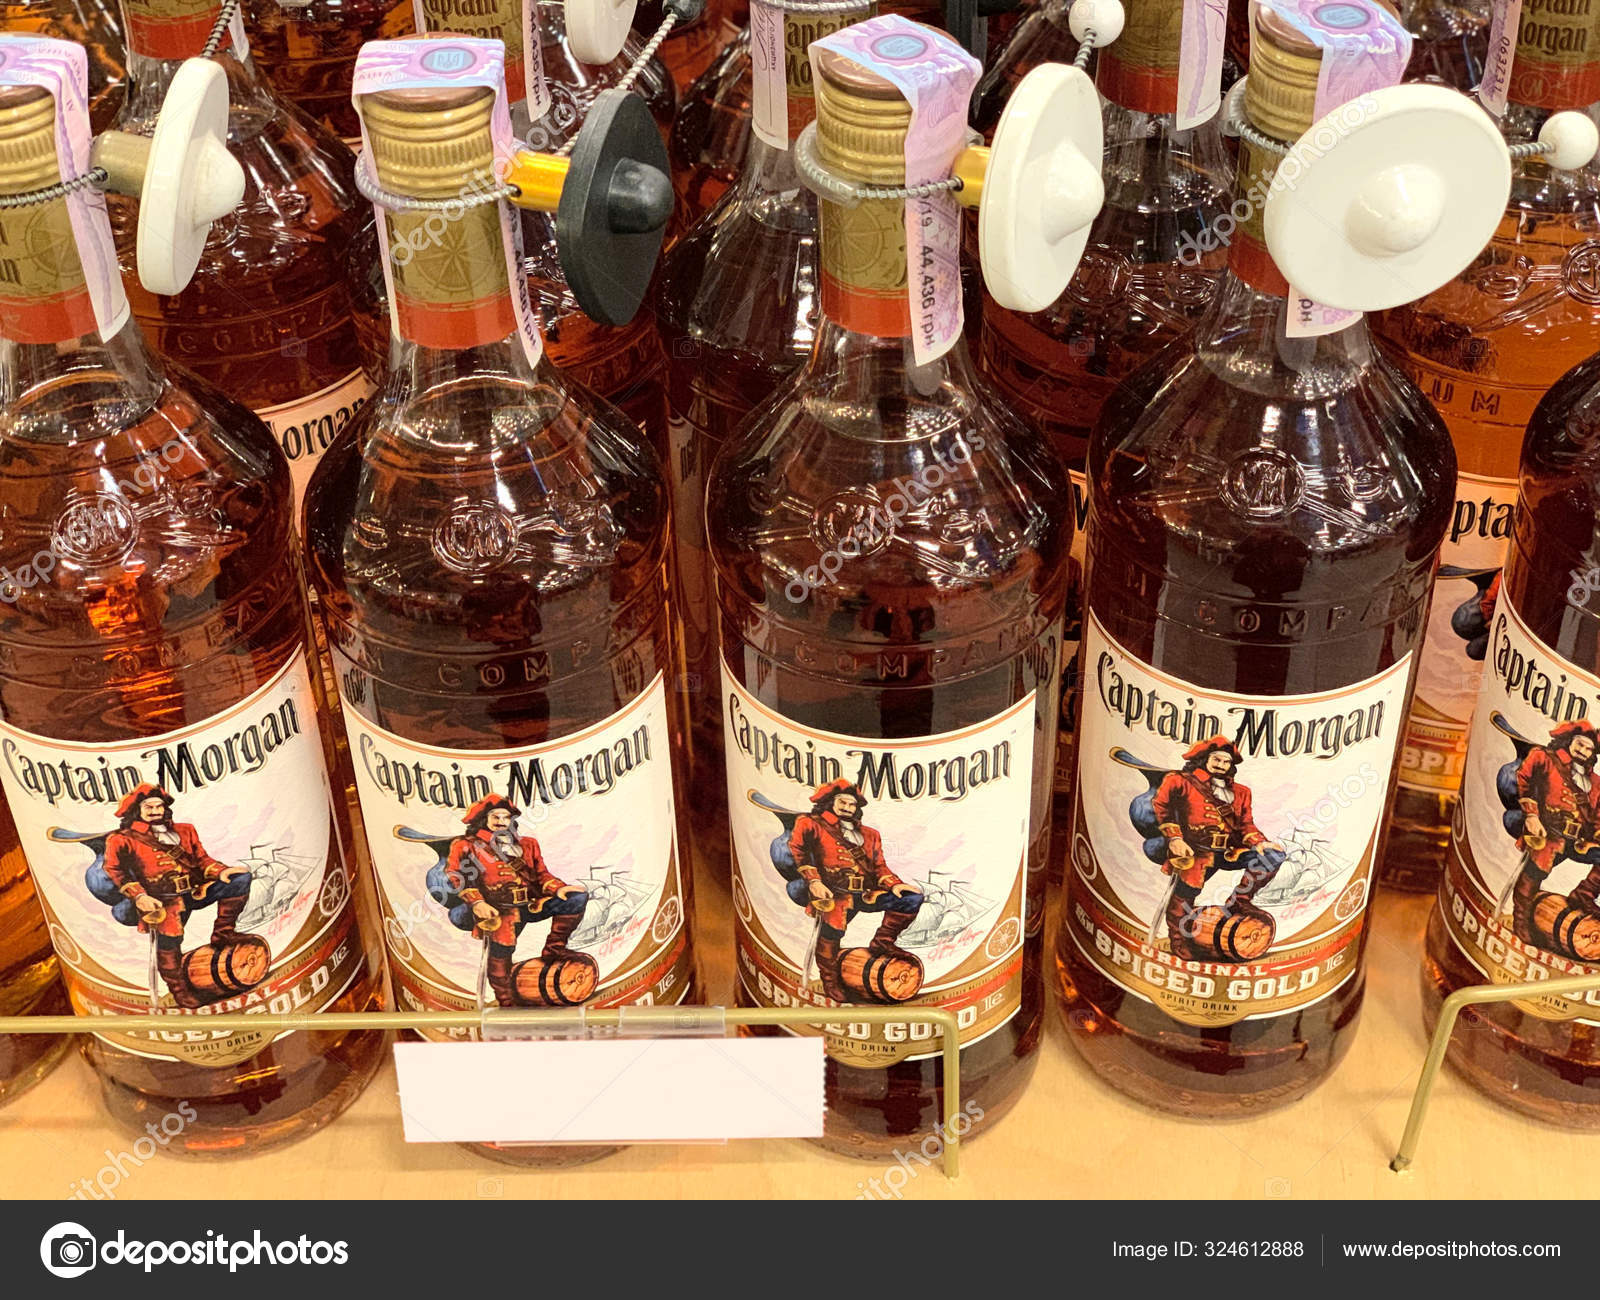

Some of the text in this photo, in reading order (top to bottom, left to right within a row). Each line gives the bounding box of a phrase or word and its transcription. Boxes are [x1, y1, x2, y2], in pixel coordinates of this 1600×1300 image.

[1097, 652, 1220, 742] Captain
[1228, 700, 1385, 760] Morgan
[1493, 613, 1589, 722] Captain
[2, 698, 302, 806] Captain Morgan
[360, 724, 652, 809] Captain Morgan
[730, 693, 1012, 801] Captain Morgan
[1095, 929, 1216, 999] SPICED
[1227, 966, 1320, 1001] GOLD
[1141, 944, 1268, 977] ORIGINAL
[1452, 893, 1550, 982] SPICED
[183, 1032, 263, 1053] SPIRIT DRINK
[827, 1036, 897, 1053] PIRIT DRINK
[1160, 992, 1239, 1013] SPIRIT DRINK
